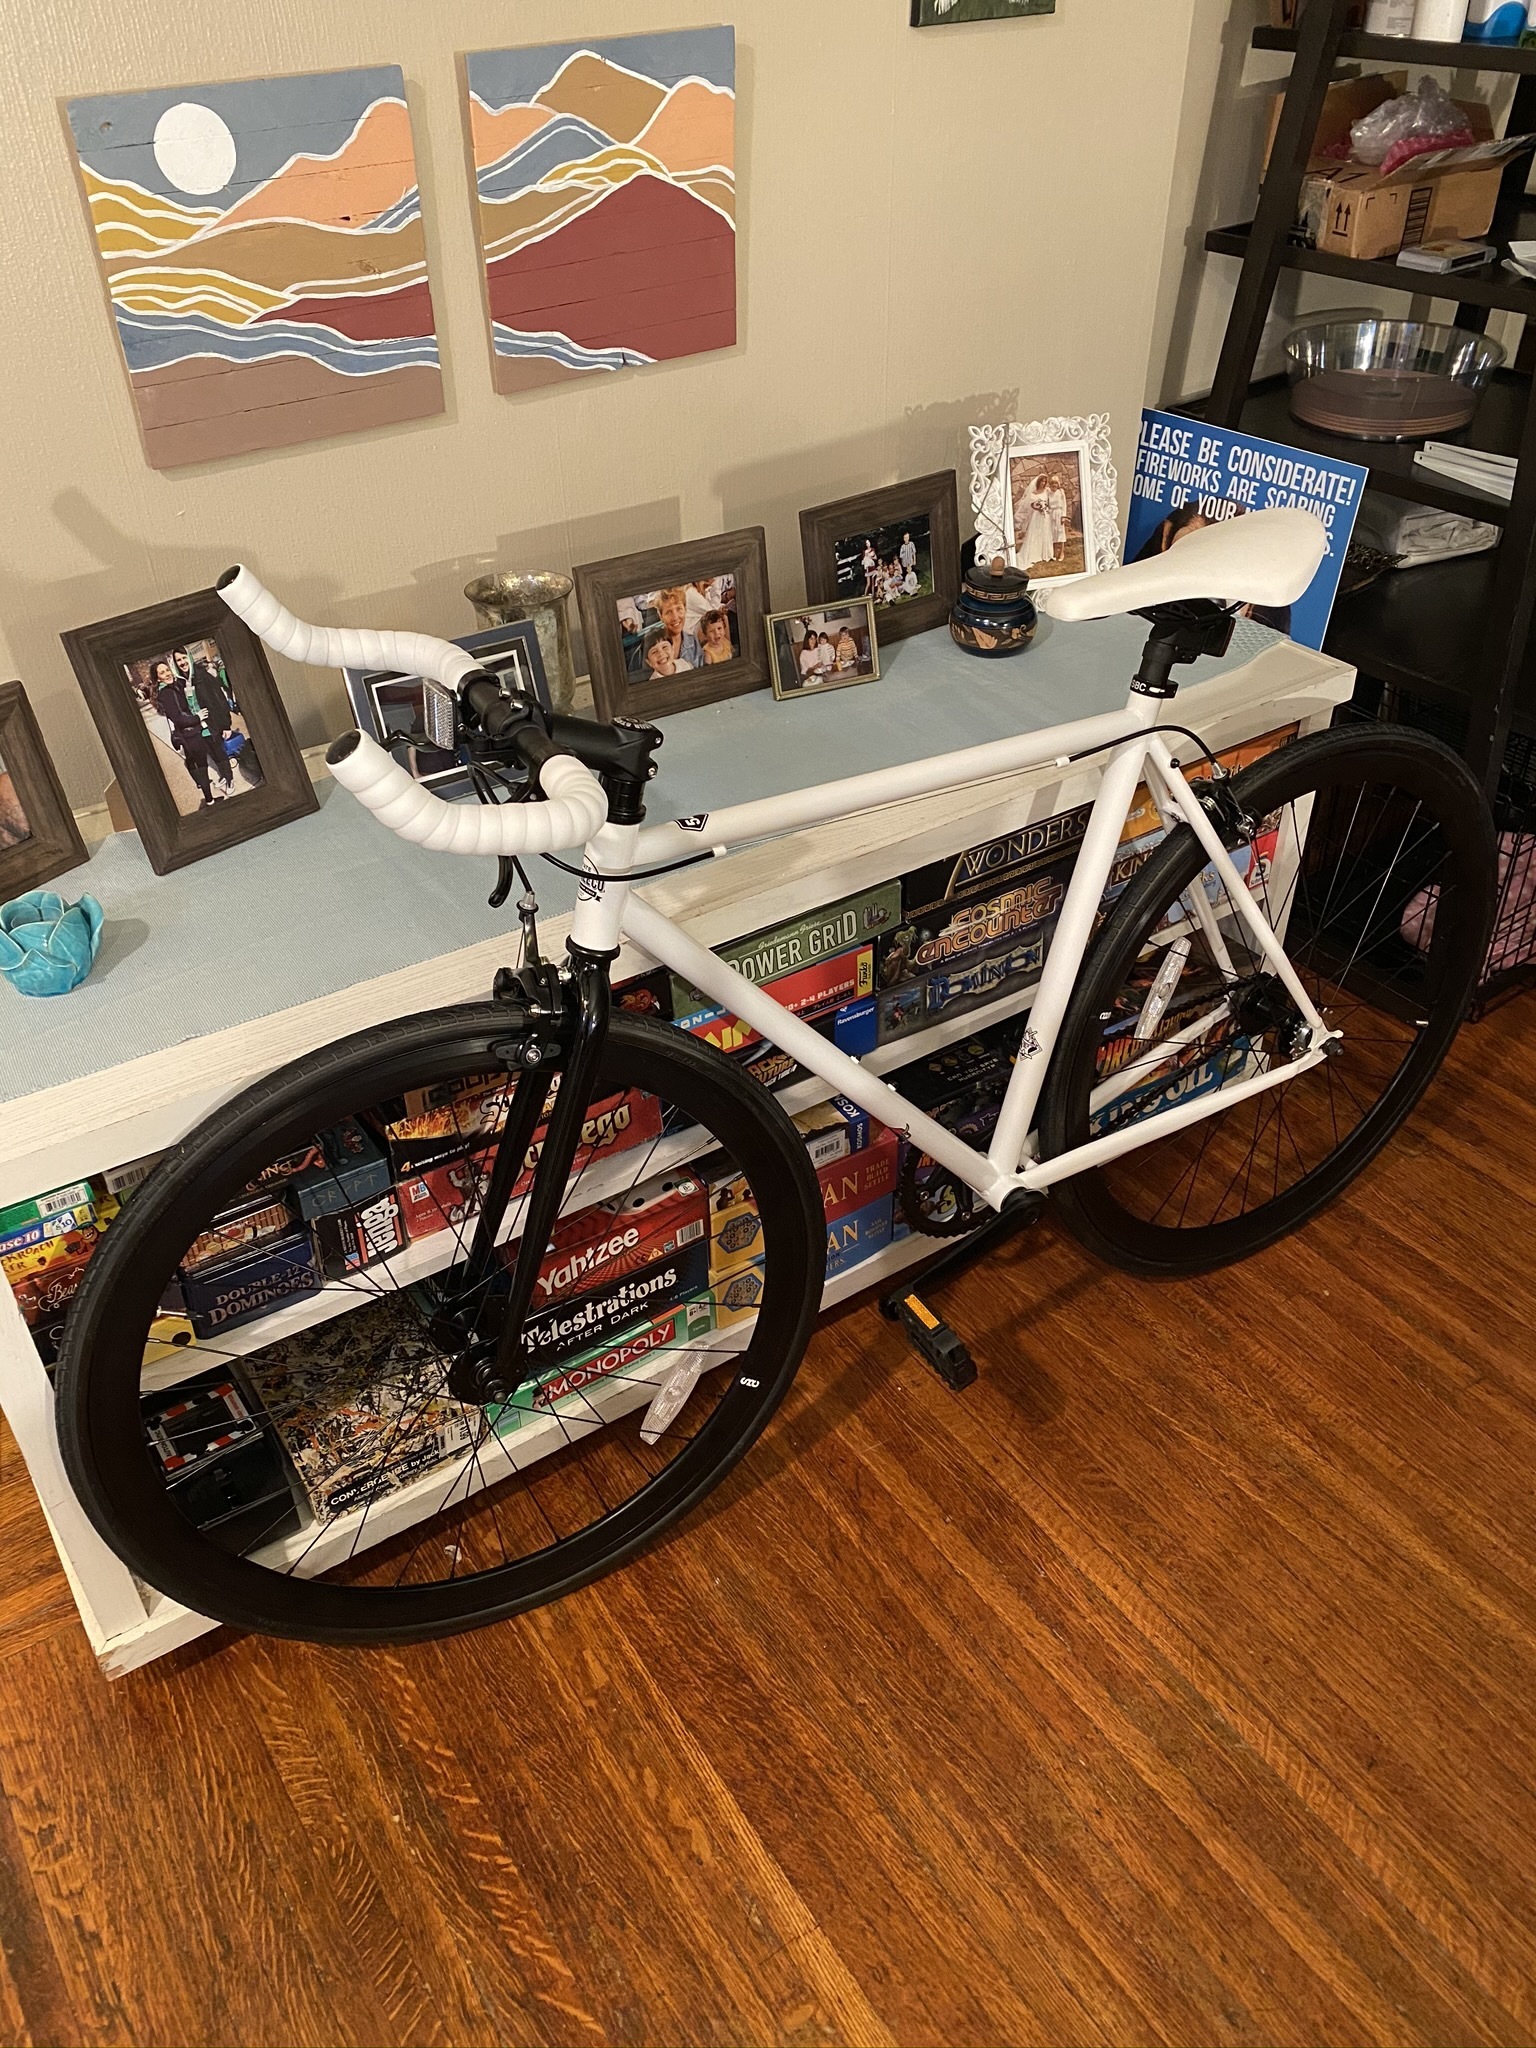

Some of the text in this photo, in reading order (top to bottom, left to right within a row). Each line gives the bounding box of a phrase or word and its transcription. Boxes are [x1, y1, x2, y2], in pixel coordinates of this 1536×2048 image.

[1136, 449, 1221, 493] FIREWORKS
[1226, 476, 1260, 505] ARE
[1197, 437, 1223, 467] BE
[1228, 446, 1357, 506] CONSIDERATE!
[1171, 485, 1192, 510] OF
[1198, 492, 1237, 522] YOUR
[964, 812, 1088, 877] WONDERS
[808, 910, 858, 956] GRID
[800, 995, 815, 1007] 2-4
[817, 979, 855, 1000] PLAYERS
[837, 1006, 875, 1026] Ravensburger
[864, 1174, 889, 1191] SETTLE
[865, 1158, 889, 1174] TRADE
[866, 1167, 888, 1182] BUILD
[824, 1172, 859, 1208] AN
[26, 1230, 39, 1244] 10
[827, 1220, 859, 1254] AN
[537, 1227, 639, 1295] Yahtzee
[208, 1271, 314, 1326] DOMINOES
[520, 1268, 677, 1353] Telestrations
[557, 1301, 648, 1352] AFTER DARK
[549, 1324, 671, 1399] MONOPOLY
[411, 1459, 420, 1468] by
